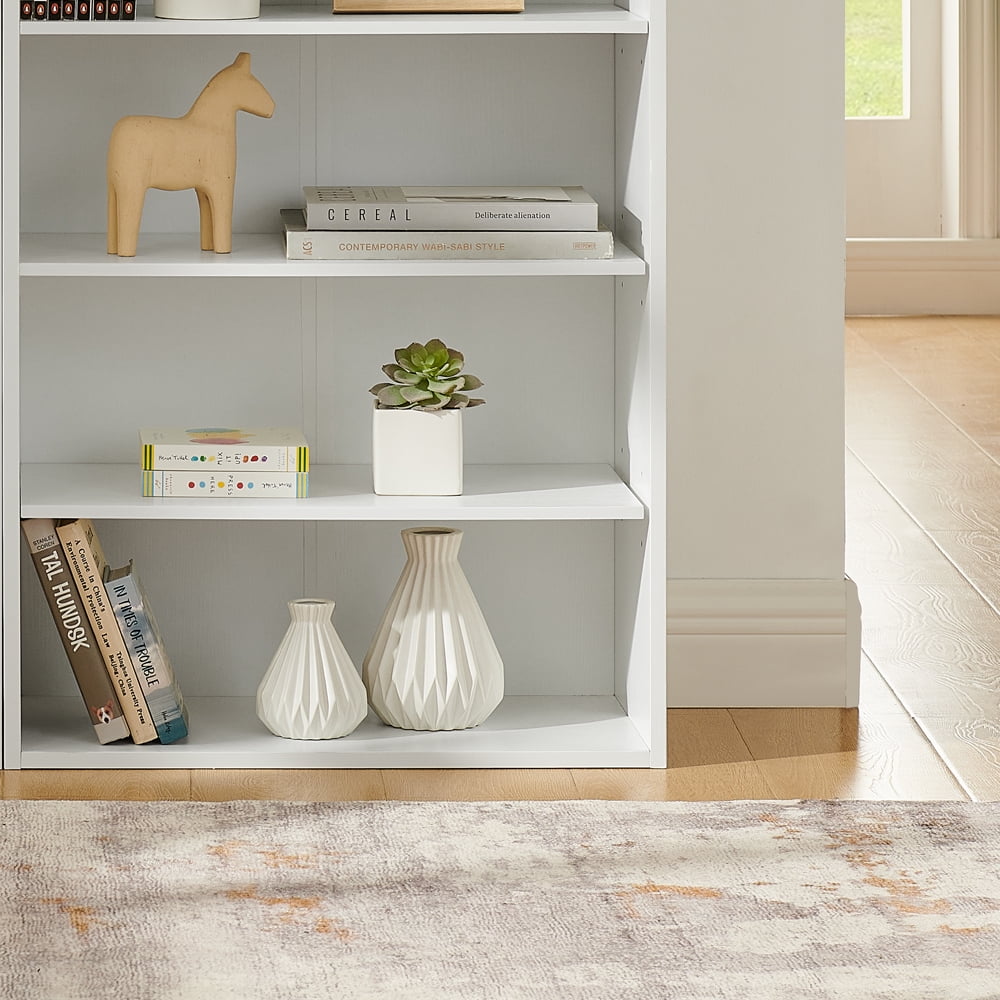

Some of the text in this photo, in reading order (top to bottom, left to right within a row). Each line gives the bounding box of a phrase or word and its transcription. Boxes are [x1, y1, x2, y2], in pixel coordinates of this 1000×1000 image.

[328, 209, 411, 221] CEREAL
[339, 243, 418, 251] CONTEMPORARY
[476, 243, 505, 251] STYLE
[32, 534, 55, 547] STANLEY
[37, 541, 55, 550] COREN
[66, 541, 110, 648] Environmental Protection Law
[78, 548, 90, 572] Course
[88, 575, 95, 584] in
[92, 586, 105, 612] China's
[41, 551, 90, 652] TAL HUNDSK
[113, 585, 160, 687] IN TIMES OF TROUBLE
[116, 651, 145, 724] Tsinghua University Press
[118, 679, 127, 696] China
